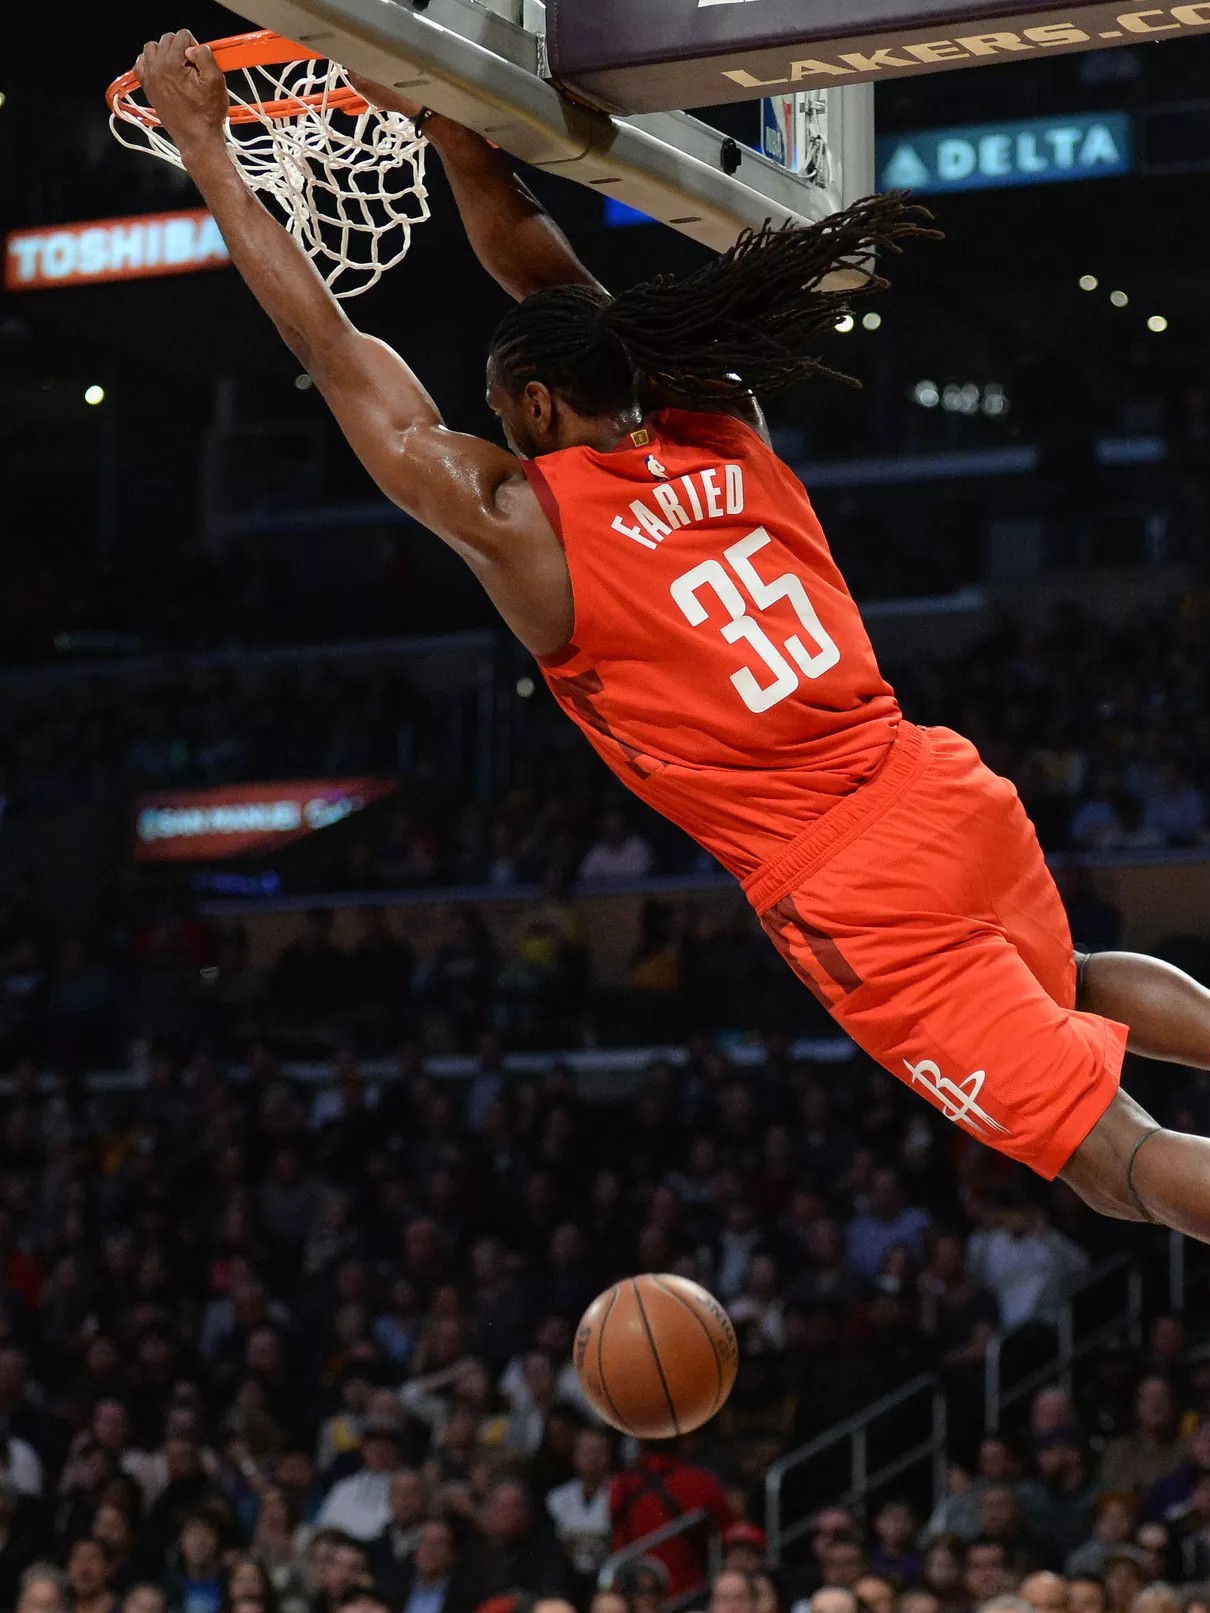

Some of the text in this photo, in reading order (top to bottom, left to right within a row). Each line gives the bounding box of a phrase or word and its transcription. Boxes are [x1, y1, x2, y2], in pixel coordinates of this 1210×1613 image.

[936, 123, 1121, 182] DELTA
[8, 215, 232, 283] TOSHIBA
[610, 464, 744, 550] FARIED
[669, 525, 841, 714] 35
